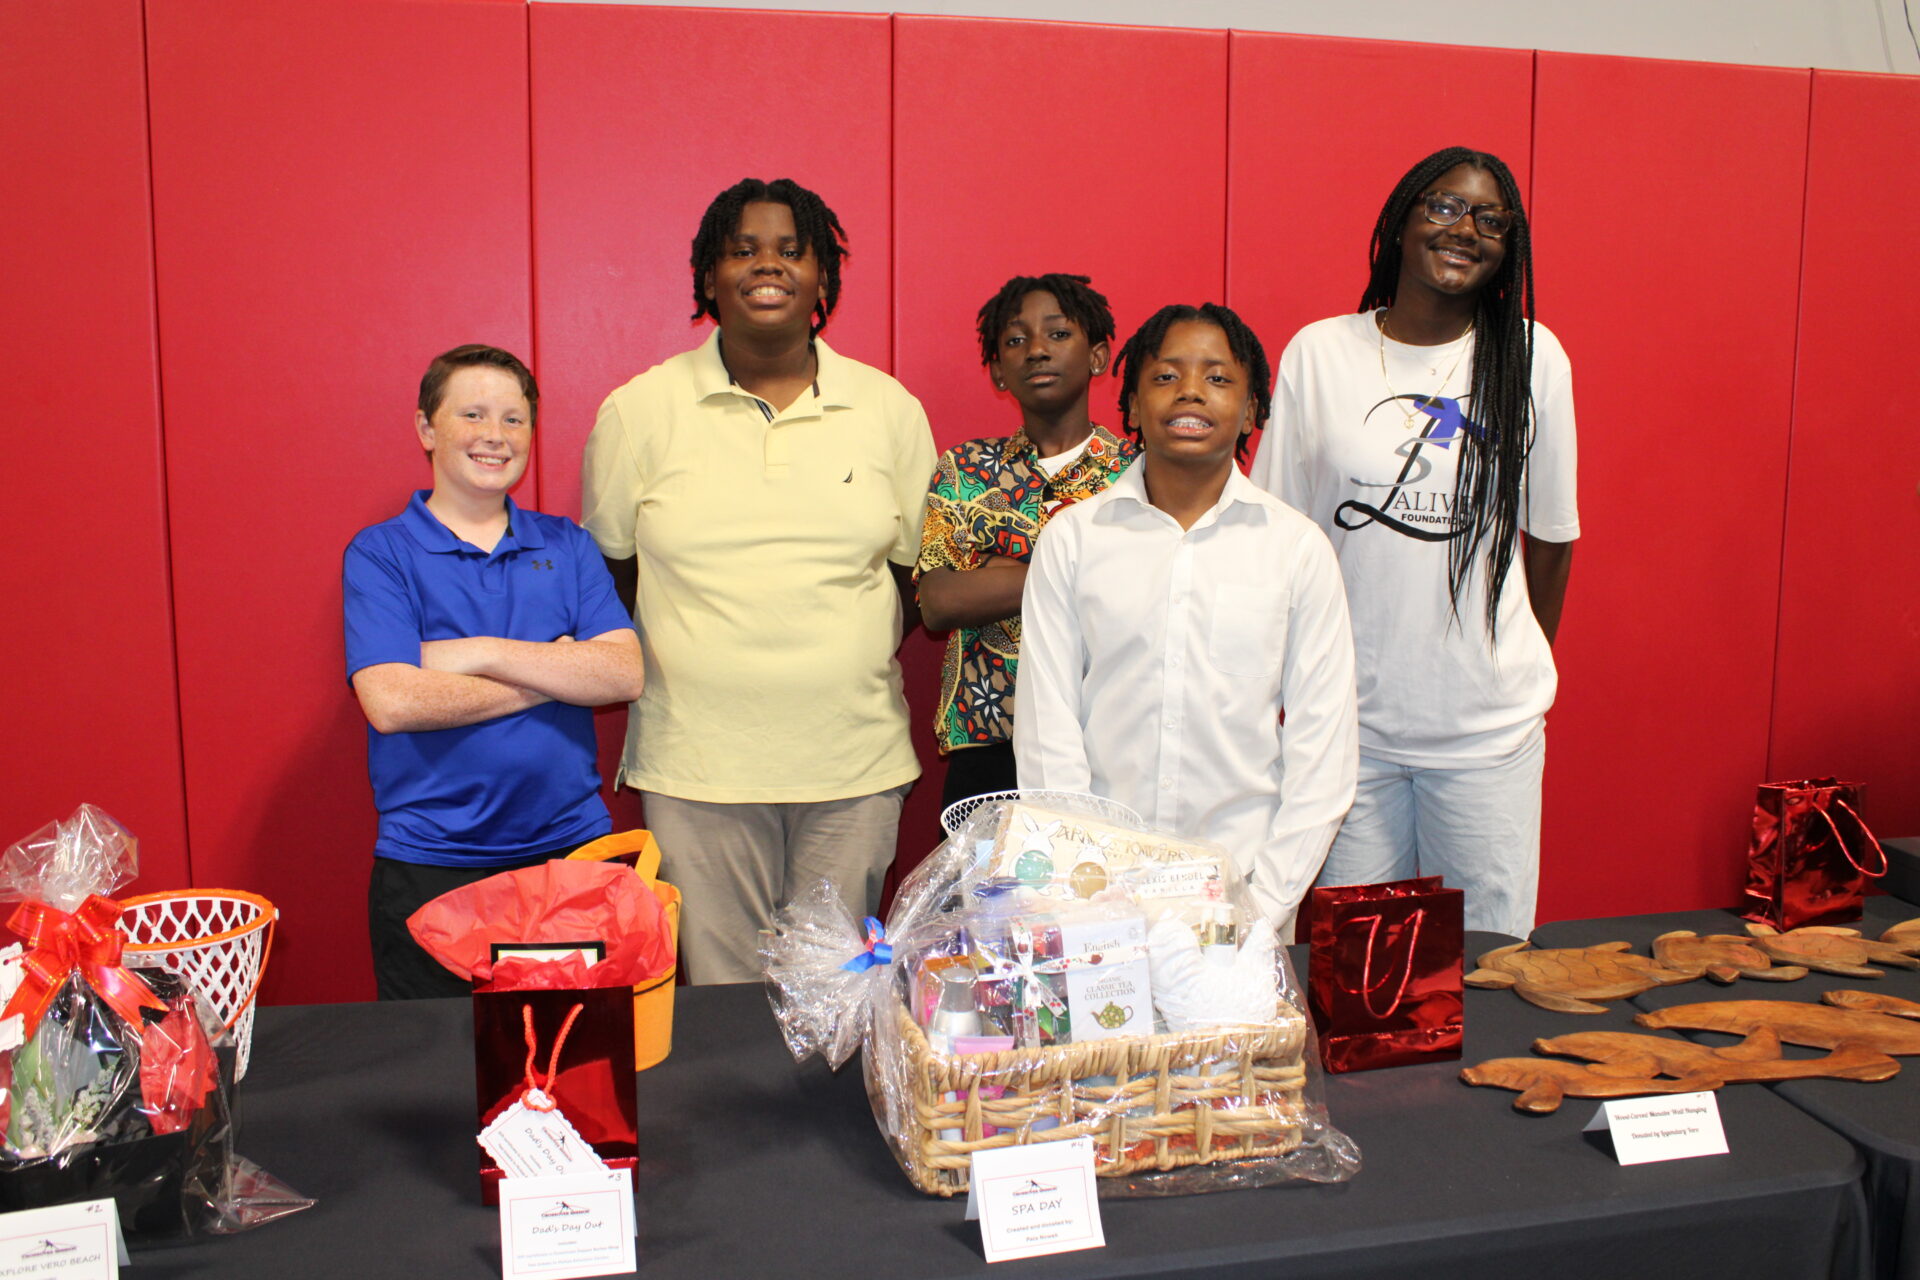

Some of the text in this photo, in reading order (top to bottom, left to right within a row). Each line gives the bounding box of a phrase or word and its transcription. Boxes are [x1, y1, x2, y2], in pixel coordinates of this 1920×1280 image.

[1401, 513, 1468, 526] FOUNDATI
[1084, 987, 1136, 1001] COLLECTION
[524, 1127, 542, 1150] Dad's
[542, 1148, 556, 1167] Day
[608, 1172, 622, 1182] #3
[86, 1204, 103, 1213] #2
[1011, 1197, 1063, 1216] SPA DAY
[532, 1220, 603, 1234] Dad's Day Out
[1006, 1225, 1029, 1234] Created
[0, 1253, 101, 1277] XPLORE VERO BEACH
